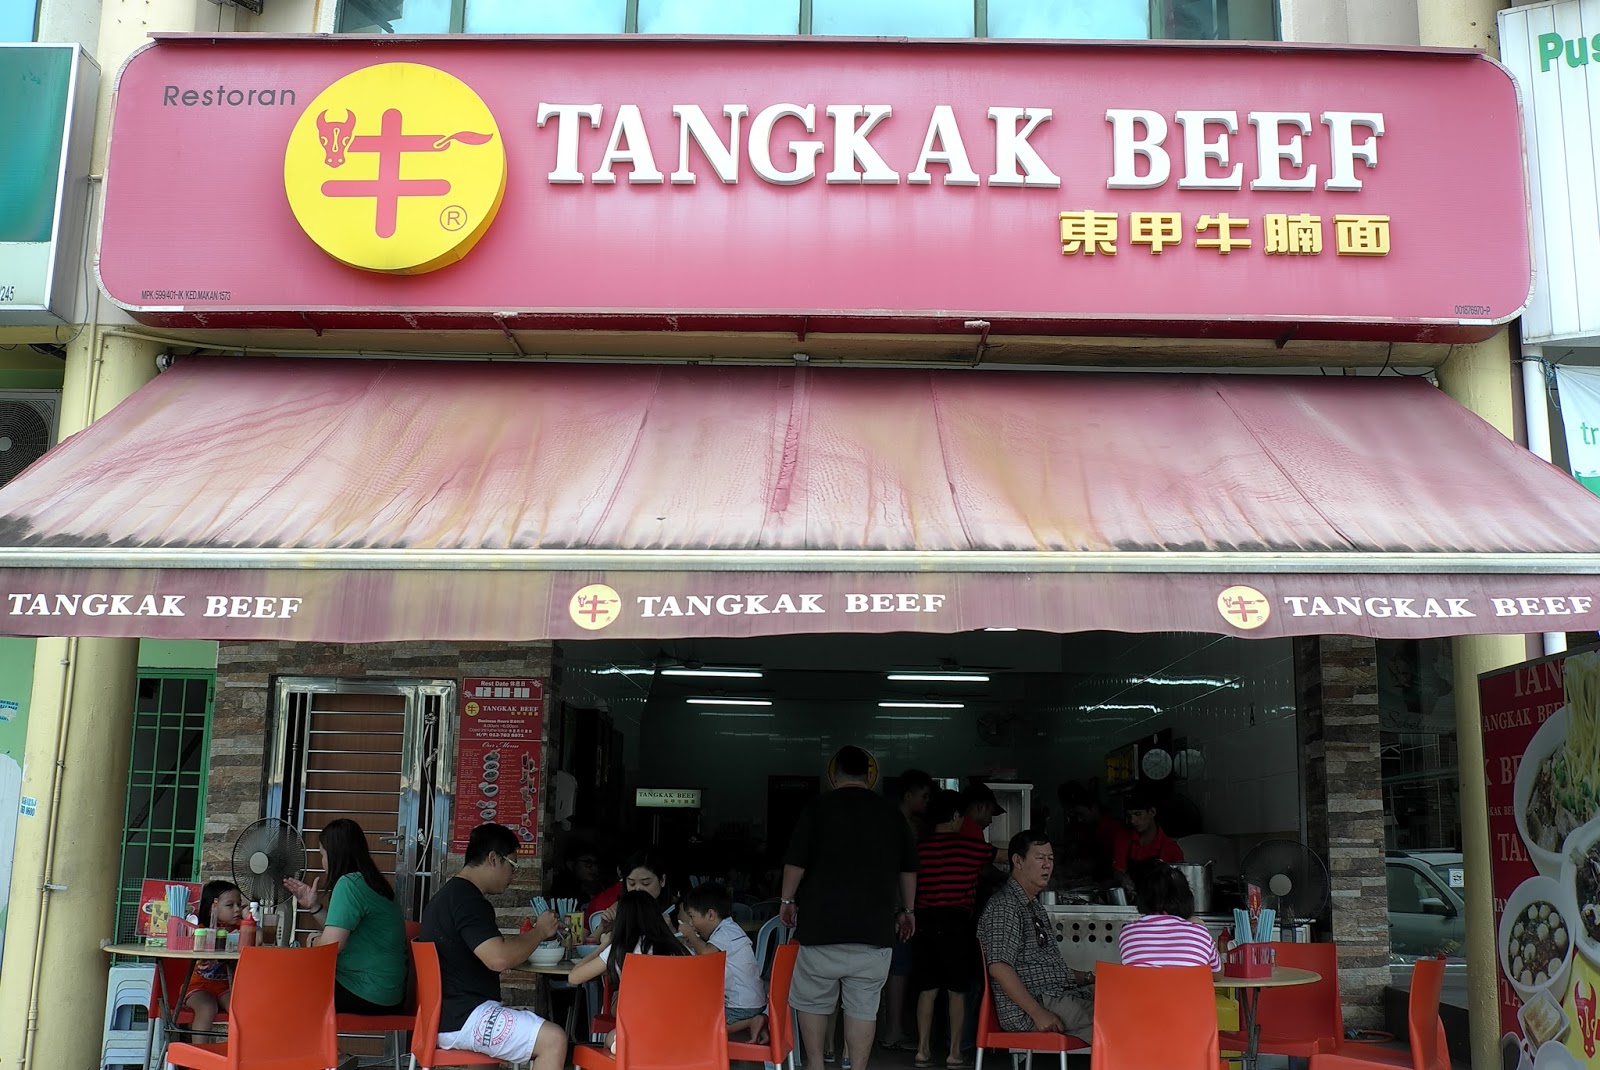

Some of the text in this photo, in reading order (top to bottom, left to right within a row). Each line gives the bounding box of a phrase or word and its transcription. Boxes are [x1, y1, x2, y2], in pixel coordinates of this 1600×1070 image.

[162, 85, 297, 107] Restoran
[537, 102, 1385, 192] TANGKAK BEEF
[1059, 209, 1391, 257] 東甲牛腩面
[1580, 421, 1599, 445] tr
[8, 593, 303, 620] TANGKAK BEEF
[637, 593, 947, 618] TANGKAK BEEF
[1283, 595, 1592, 619] TANGKAK BEEF
[1497, 833, 1529, 862] TA
[1494, 898, 1508, 912] TA
